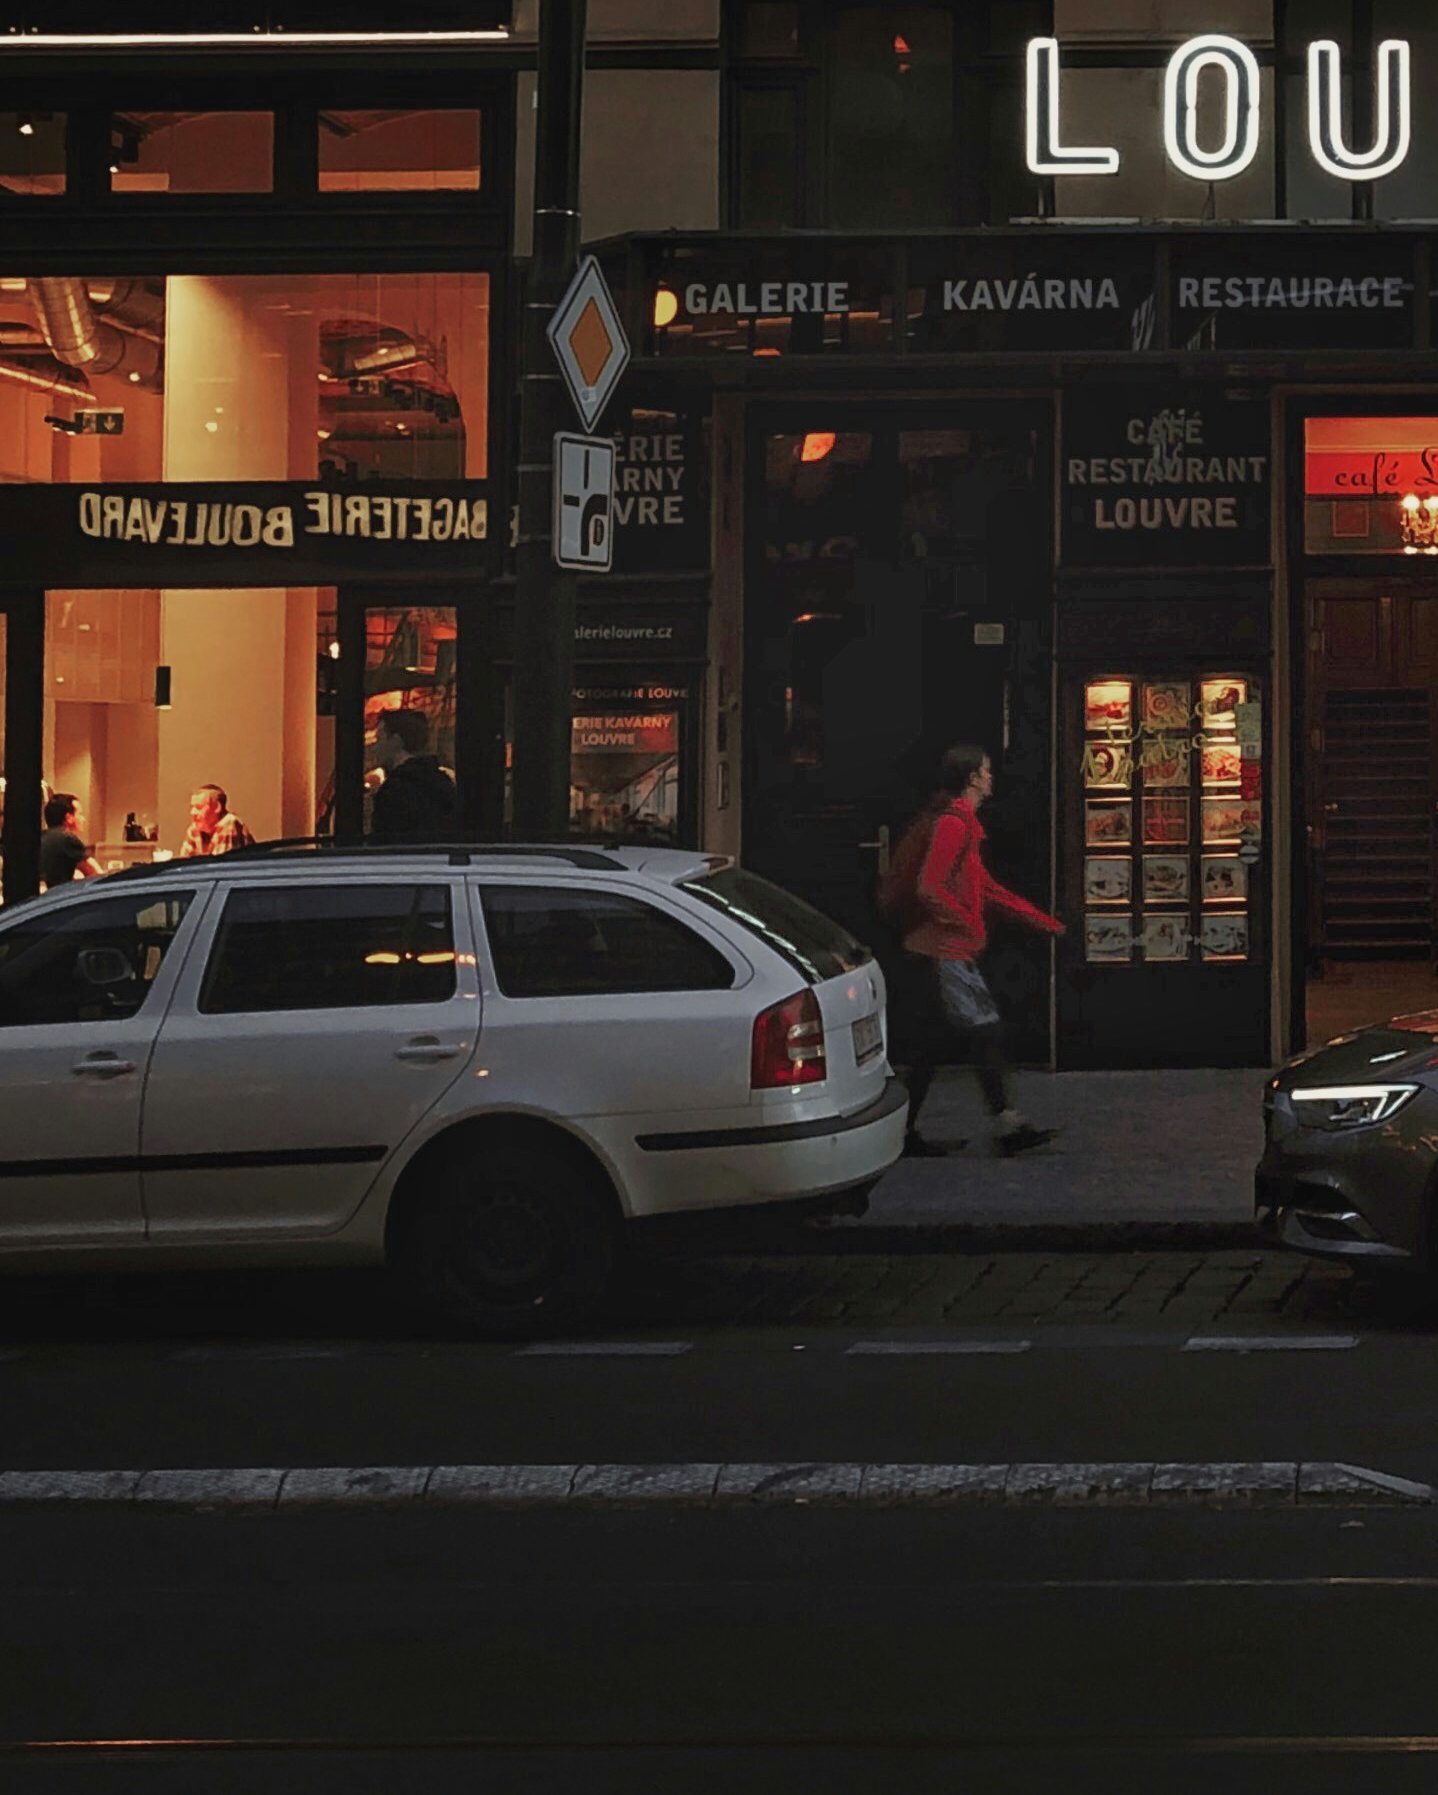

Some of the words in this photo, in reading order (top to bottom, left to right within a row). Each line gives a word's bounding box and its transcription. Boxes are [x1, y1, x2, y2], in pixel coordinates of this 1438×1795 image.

[685, 282, 850, 315] GALERIE
[943, 271, 1120, 311] KAVÁRNA
[1178, 276, 1404, 309] RESTAURACE
[1068, 456, 1267, 485] RESTAURANT
[1334, 452, 1400, 495] café
[1095, 497, 1239, 529] LOUVRE
